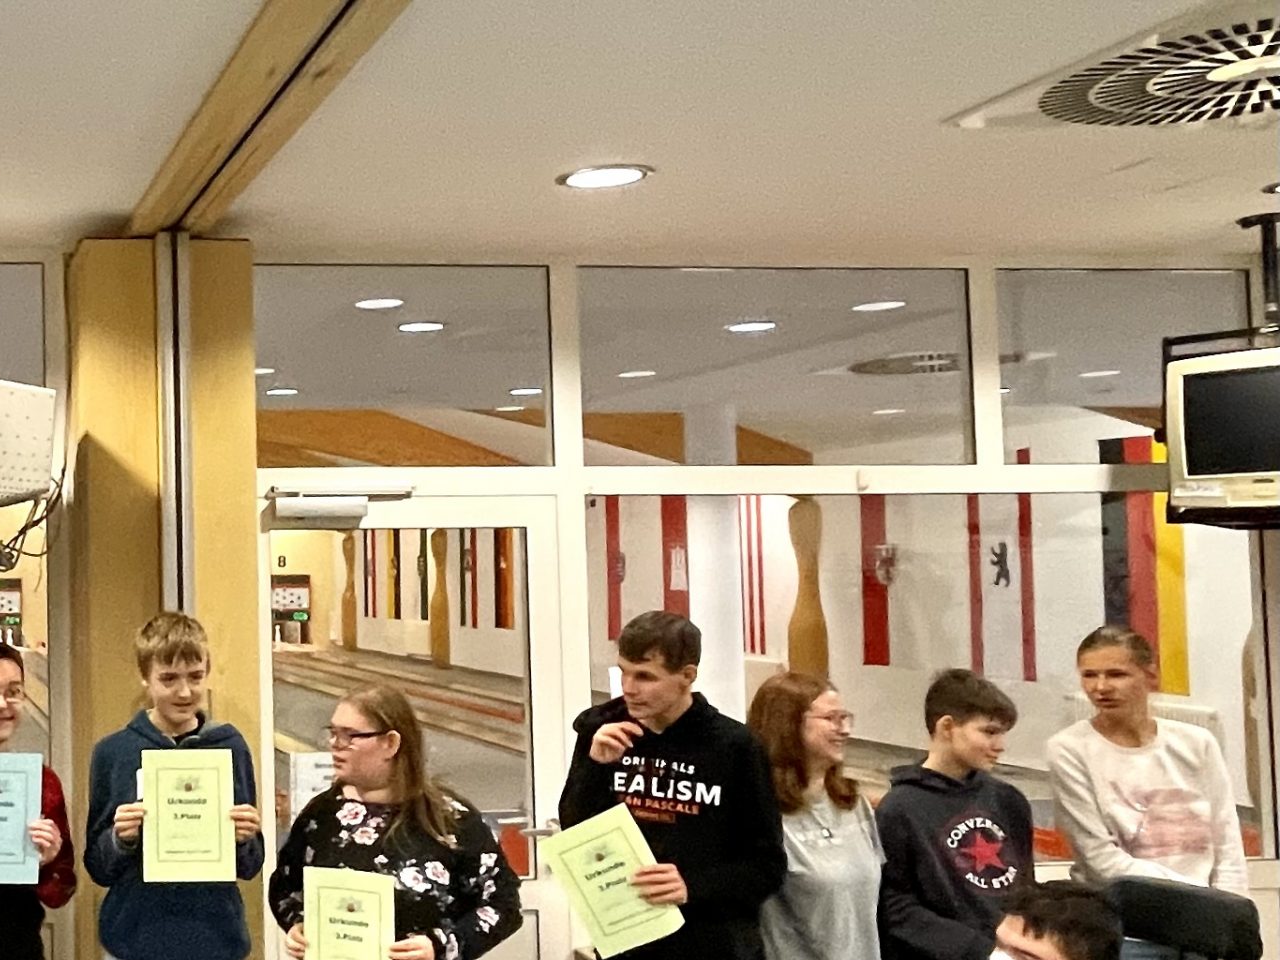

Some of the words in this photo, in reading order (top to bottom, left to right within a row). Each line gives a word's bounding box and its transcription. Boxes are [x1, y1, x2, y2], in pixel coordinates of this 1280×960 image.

[277, 555, 286, 568] 8
[611, 771, 722, 807] EALISM
[644, 798, 700, 815] PASCALE
[965, 872, 989, 889] ALL
[991, 866, 1018, 889] STAR
